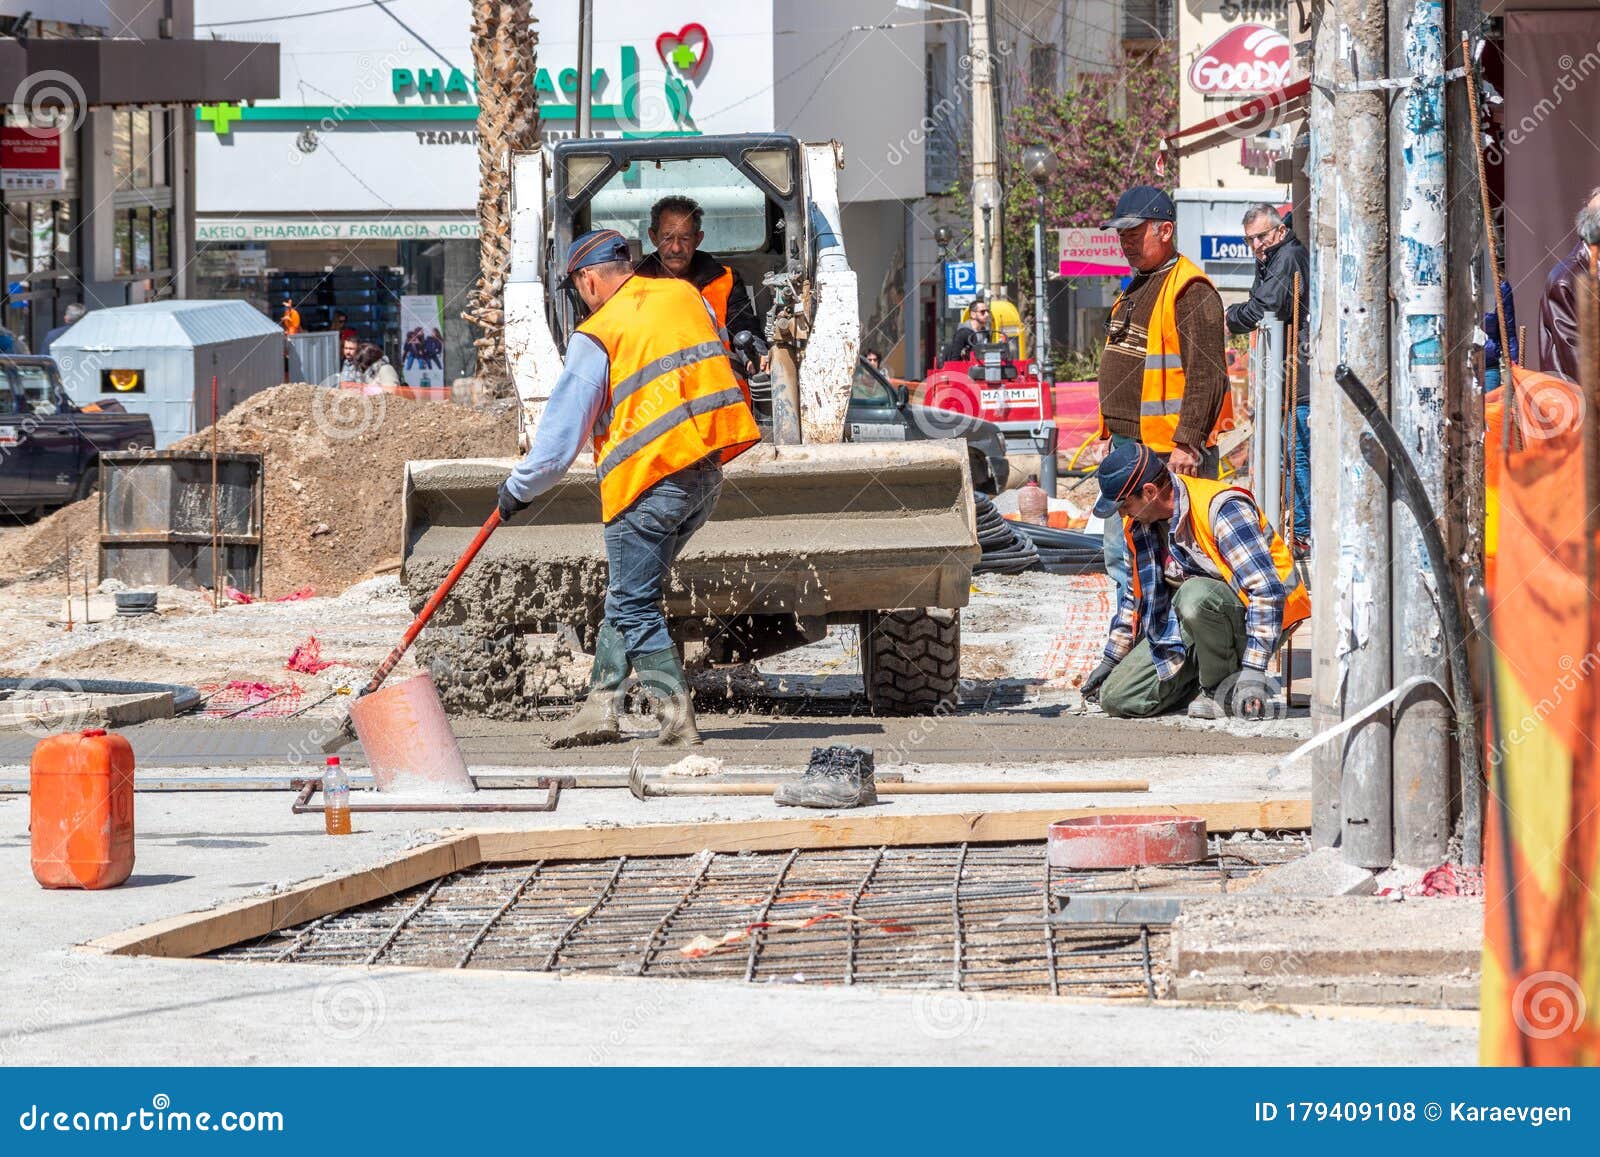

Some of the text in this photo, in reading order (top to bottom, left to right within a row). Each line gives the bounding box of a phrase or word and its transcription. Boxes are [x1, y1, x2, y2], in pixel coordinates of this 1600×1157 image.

[392, 68, 605, 94] PHAACY
[1193, 56, 1290, 89] GOODY
[254, 225, 341, 237] PHARMACY
[350, 225, 429, 236] FARMACIA
